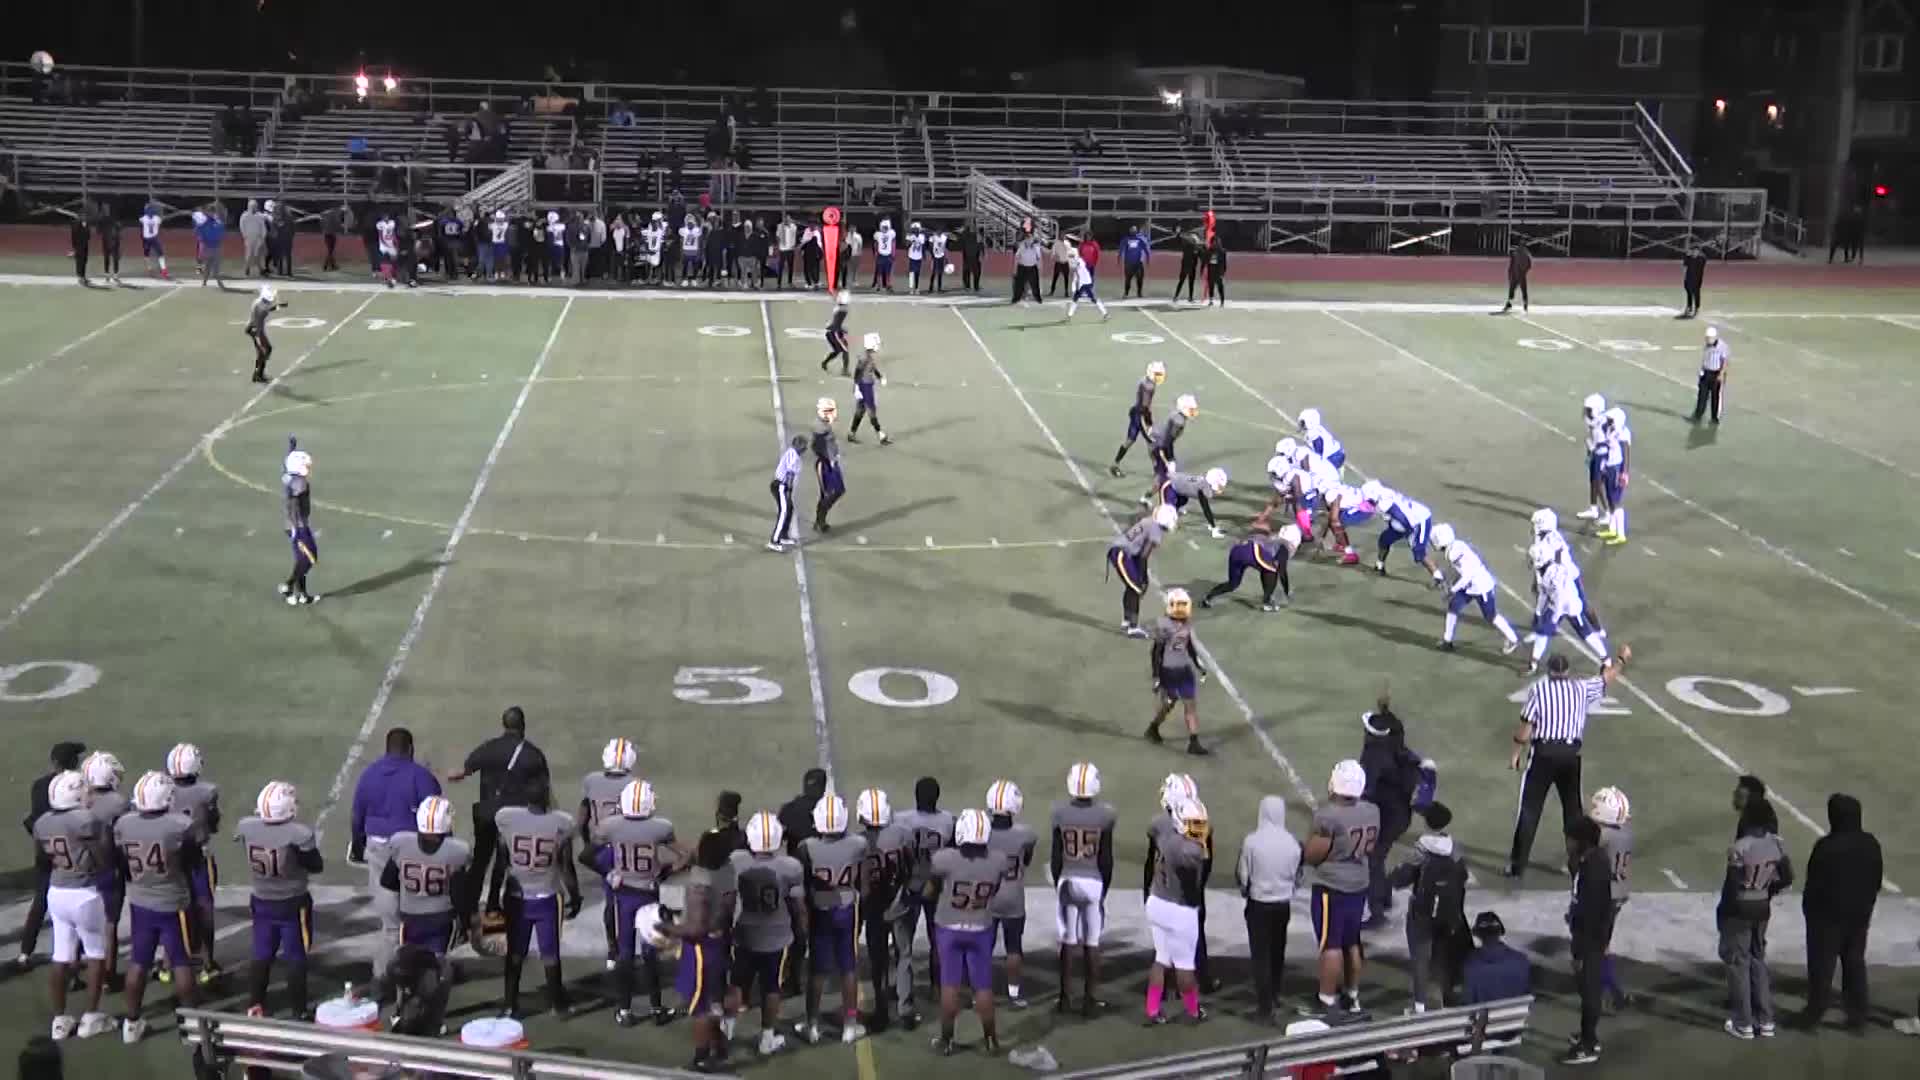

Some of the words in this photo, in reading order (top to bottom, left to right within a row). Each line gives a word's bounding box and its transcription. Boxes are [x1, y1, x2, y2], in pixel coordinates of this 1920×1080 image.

[124, 843, 167, 875] 54
[249, 845, 282, 878] 51
[513, 835, 556, 868] 55
[619, 843, 653, 873] 16
[402, 862, 446, 895] 56
